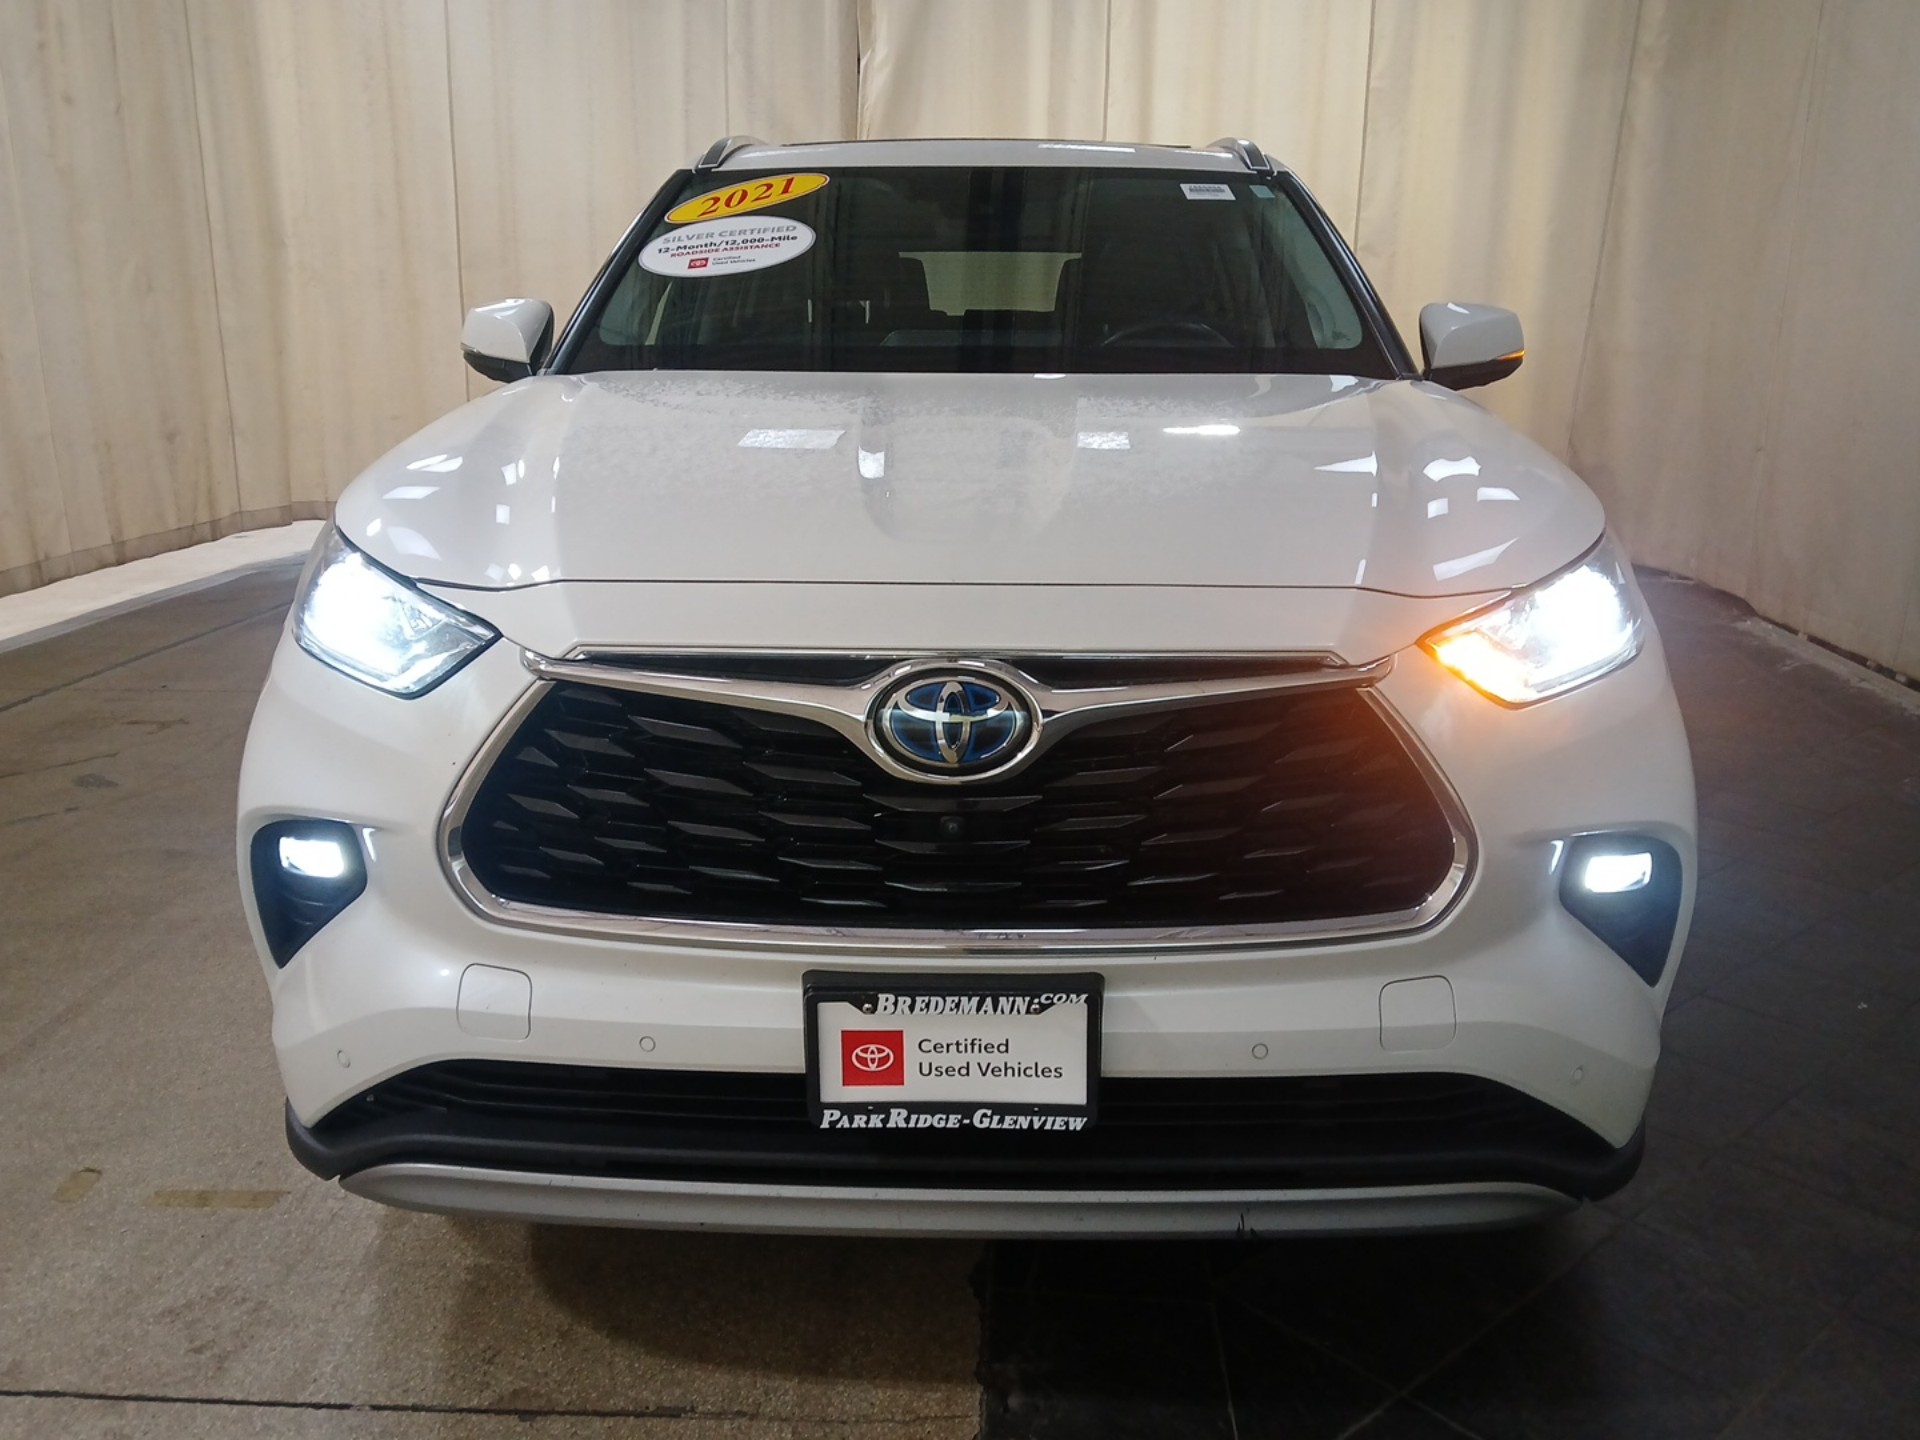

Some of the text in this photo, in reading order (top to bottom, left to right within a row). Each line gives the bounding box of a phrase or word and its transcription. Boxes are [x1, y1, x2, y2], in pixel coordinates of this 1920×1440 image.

[698, 176, 796, 217] 2021
[662, 225, 797, 244] SILVER CERTIFIED
[657, 235, 798, 254] 12-Month/12,000-Mile
[670, 242, 781, 258] ROADSIDE ASSISTANCE
[918, 1038, 1010, 1054] Certified
[918, 1061, 1064, 1079] Used Vehicles
[820, 1108, 885, 1129] PARK
